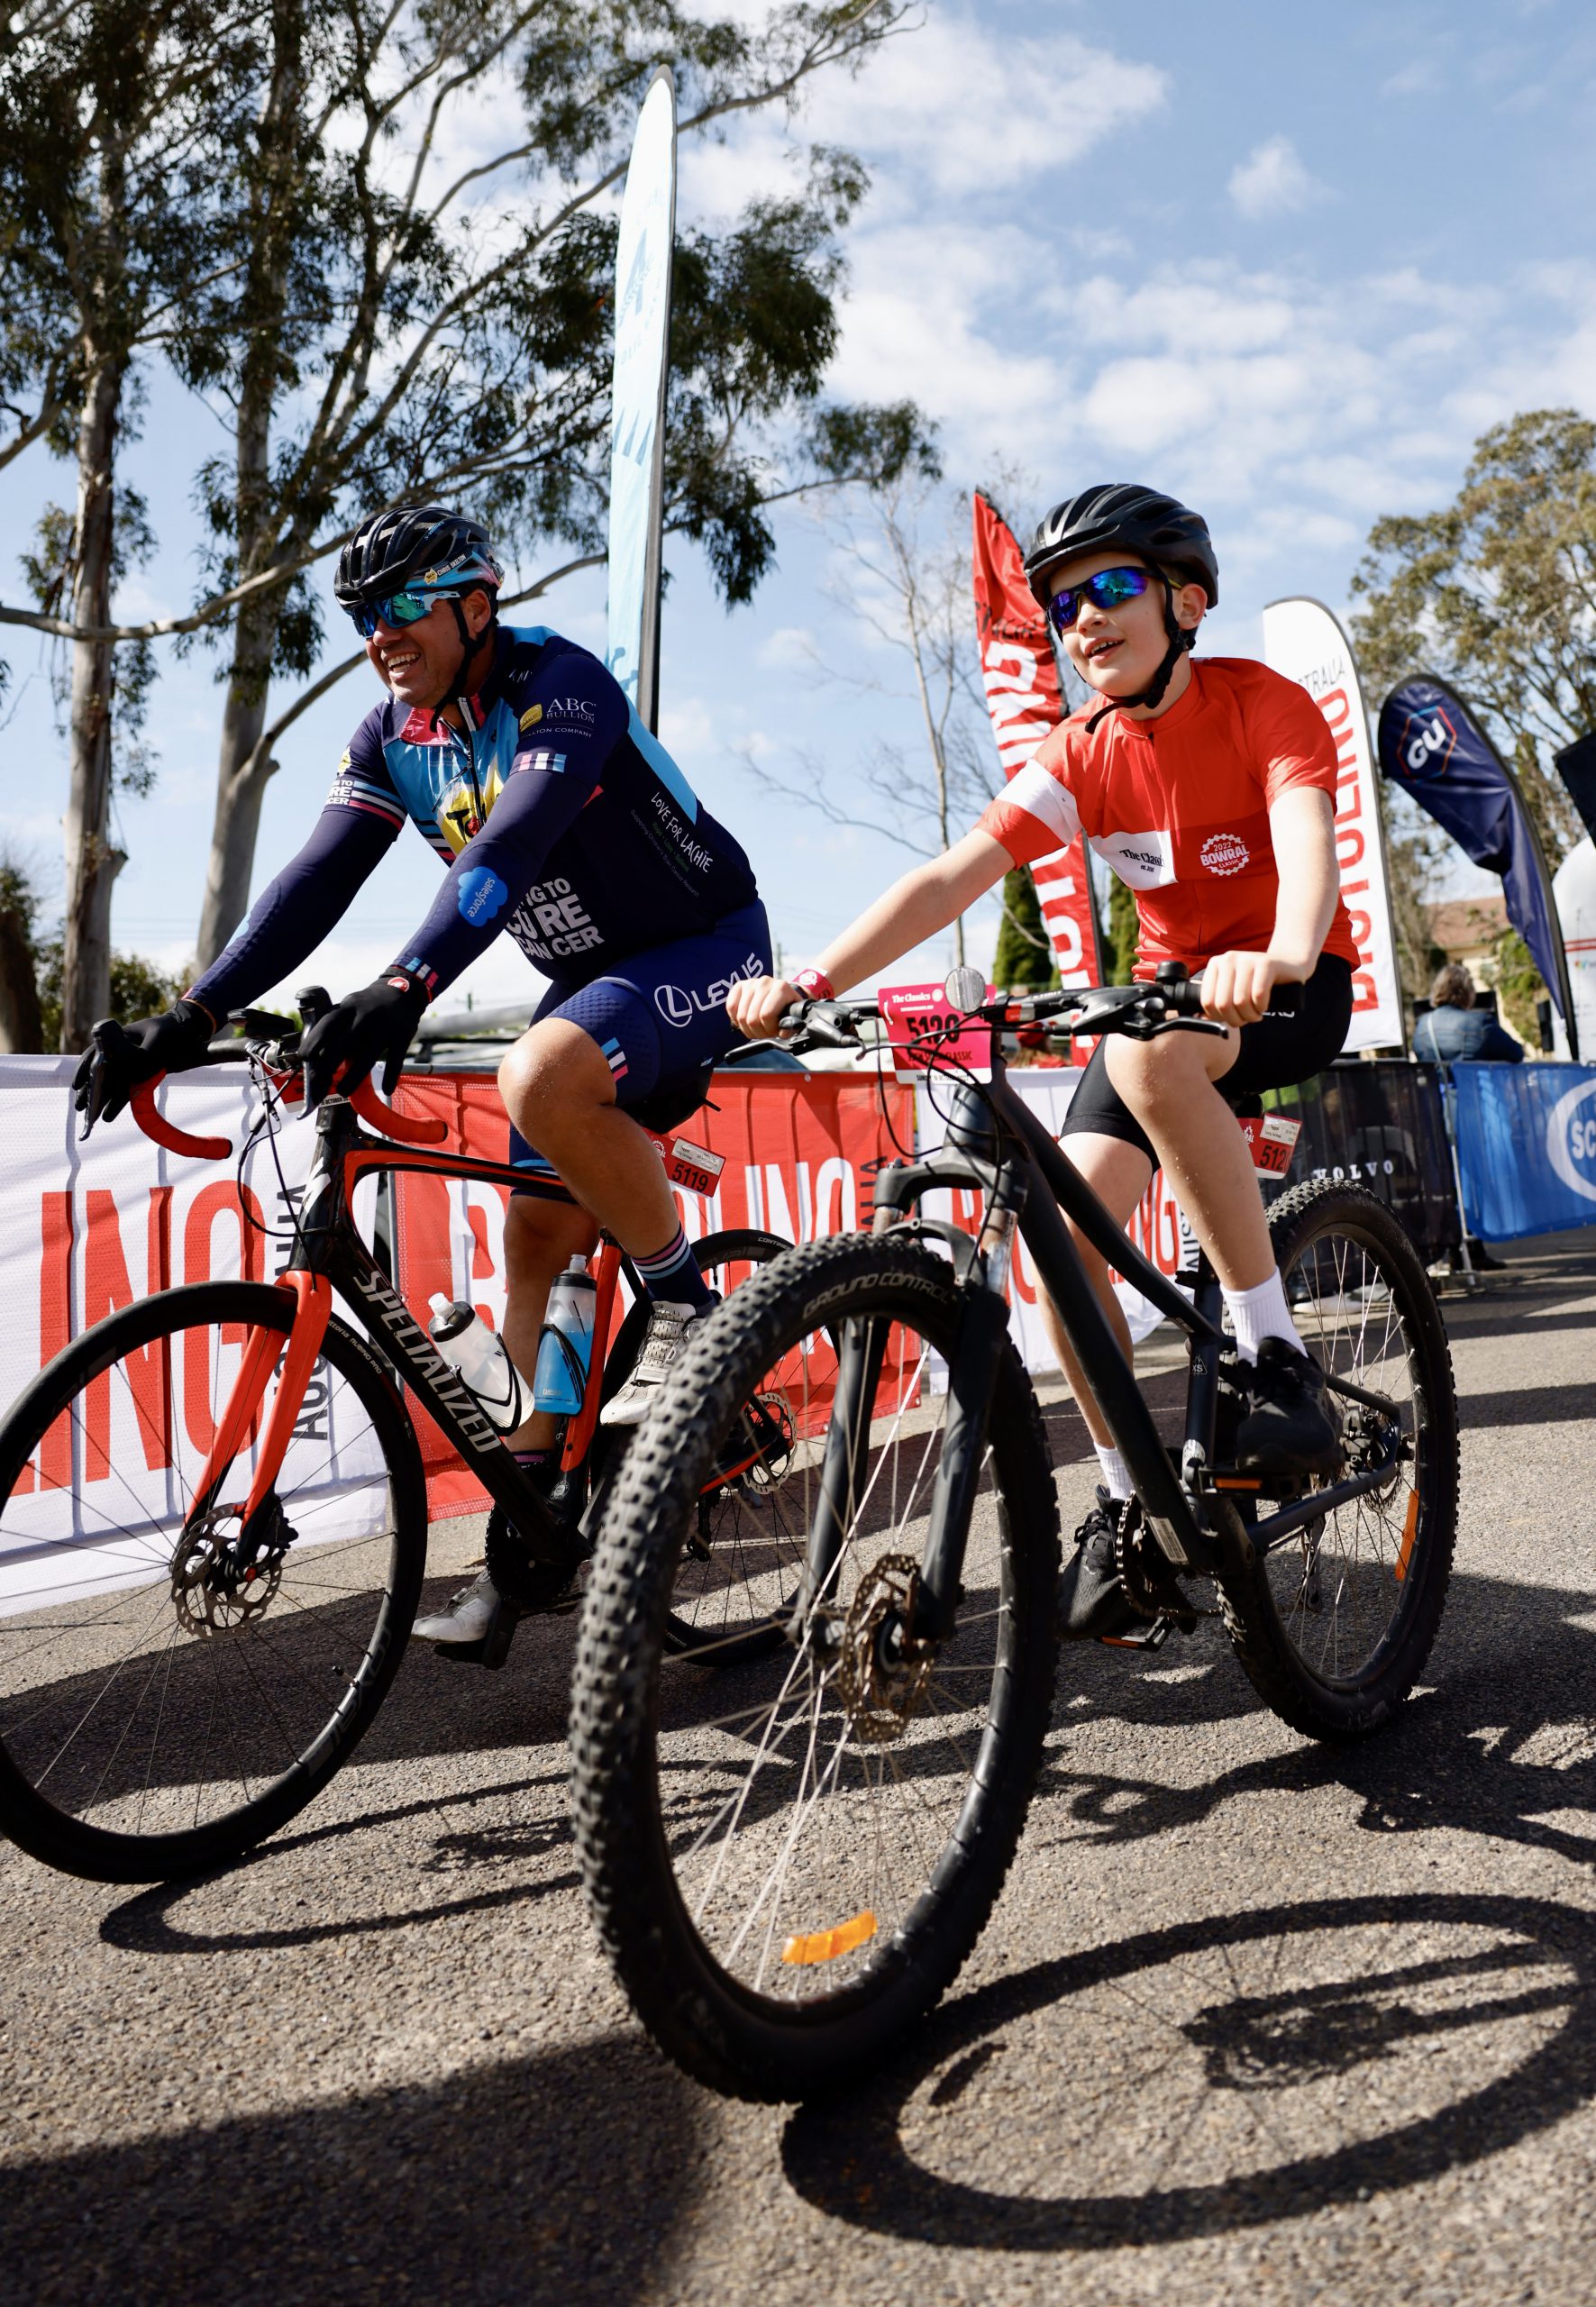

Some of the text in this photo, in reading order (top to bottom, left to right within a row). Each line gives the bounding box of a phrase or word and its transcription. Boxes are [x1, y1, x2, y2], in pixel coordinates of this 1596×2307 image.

[546, 698, 597, 717] ABC
[546, 710, 596, 724] BULLION
[554, 727, 592, 738] COMPANY
[1407, 718, 1446, 770] GU
[651, 792, 714, 873] LOVE FOR LACHIE
[1119, 849, 1141, 861] The
[1199, 843, 1251, 867] BOWRAL
[1213, 841, 1233, 853] 2022
[1218, 859, 1241, 870] CLASSIC
[467, 877, 496, 917] salesforce
[543, 878, 571, 898] TO
[892, 992, 931, 1003] The Classics
[1260, 1144, 1287, 1171] 512
[672, 1163, 708, 1192] 5119
[1312, 1159, 1394, 1181] VOLVO
[802, 1272, 950, 1320] GROUND CONTROL
[328, 1318, 350, 1338] ittoria
[352, 1269, 502, 1453] SPECIALIZED
[1191, 1363, 1204, 1374] XS
